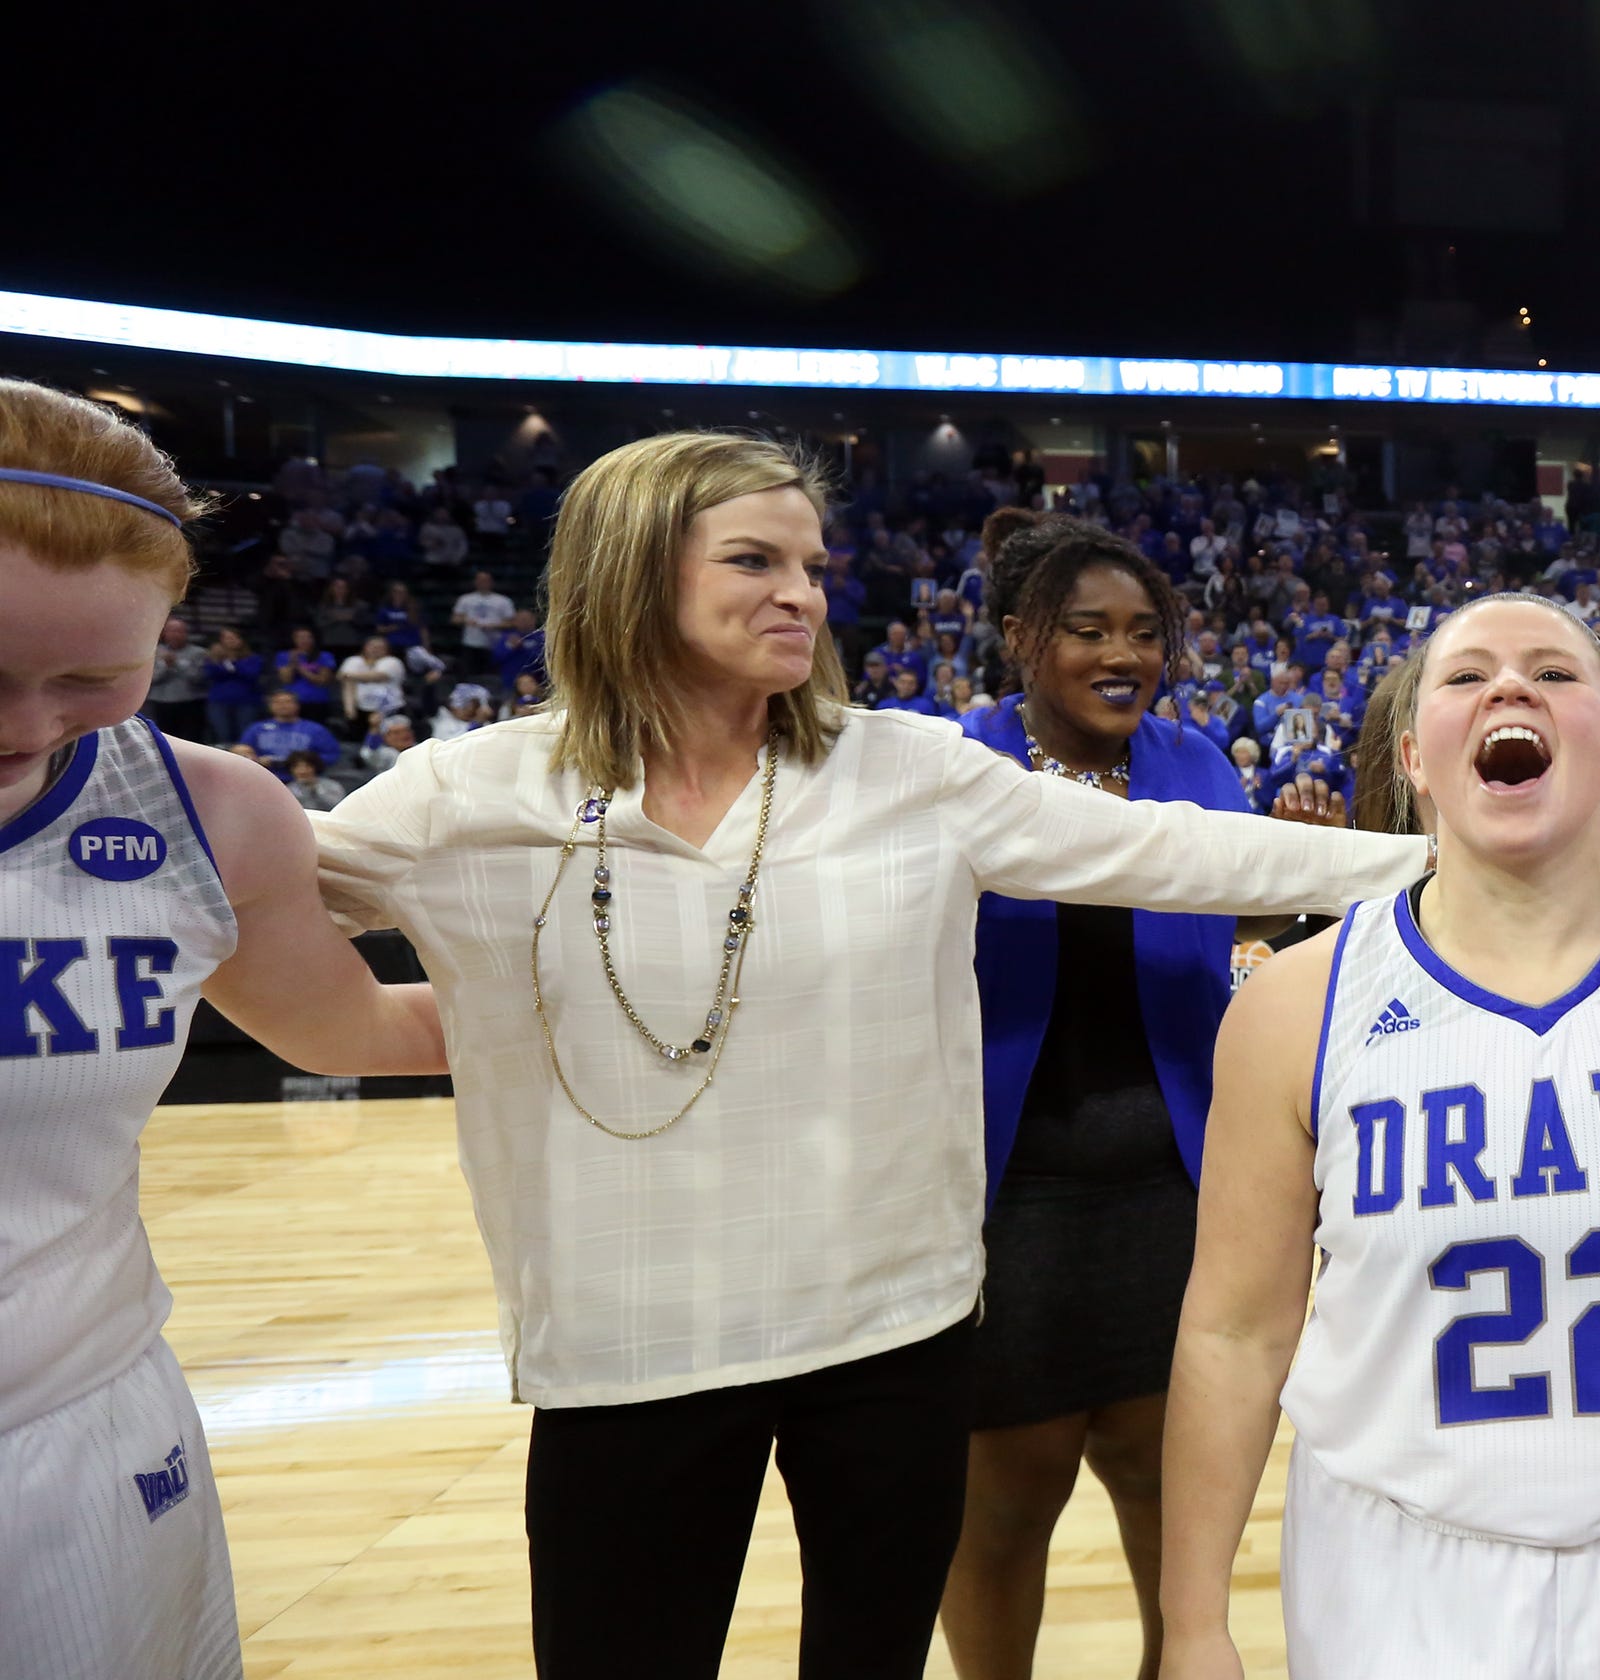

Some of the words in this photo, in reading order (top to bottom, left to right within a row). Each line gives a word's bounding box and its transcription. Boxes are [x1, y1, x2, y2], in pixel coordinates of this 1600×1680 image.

[1395, 369, 1428, 398] TV
[1431, 371, 1554, 402] NETWORK
[78, 834, 159, 862] PFM
